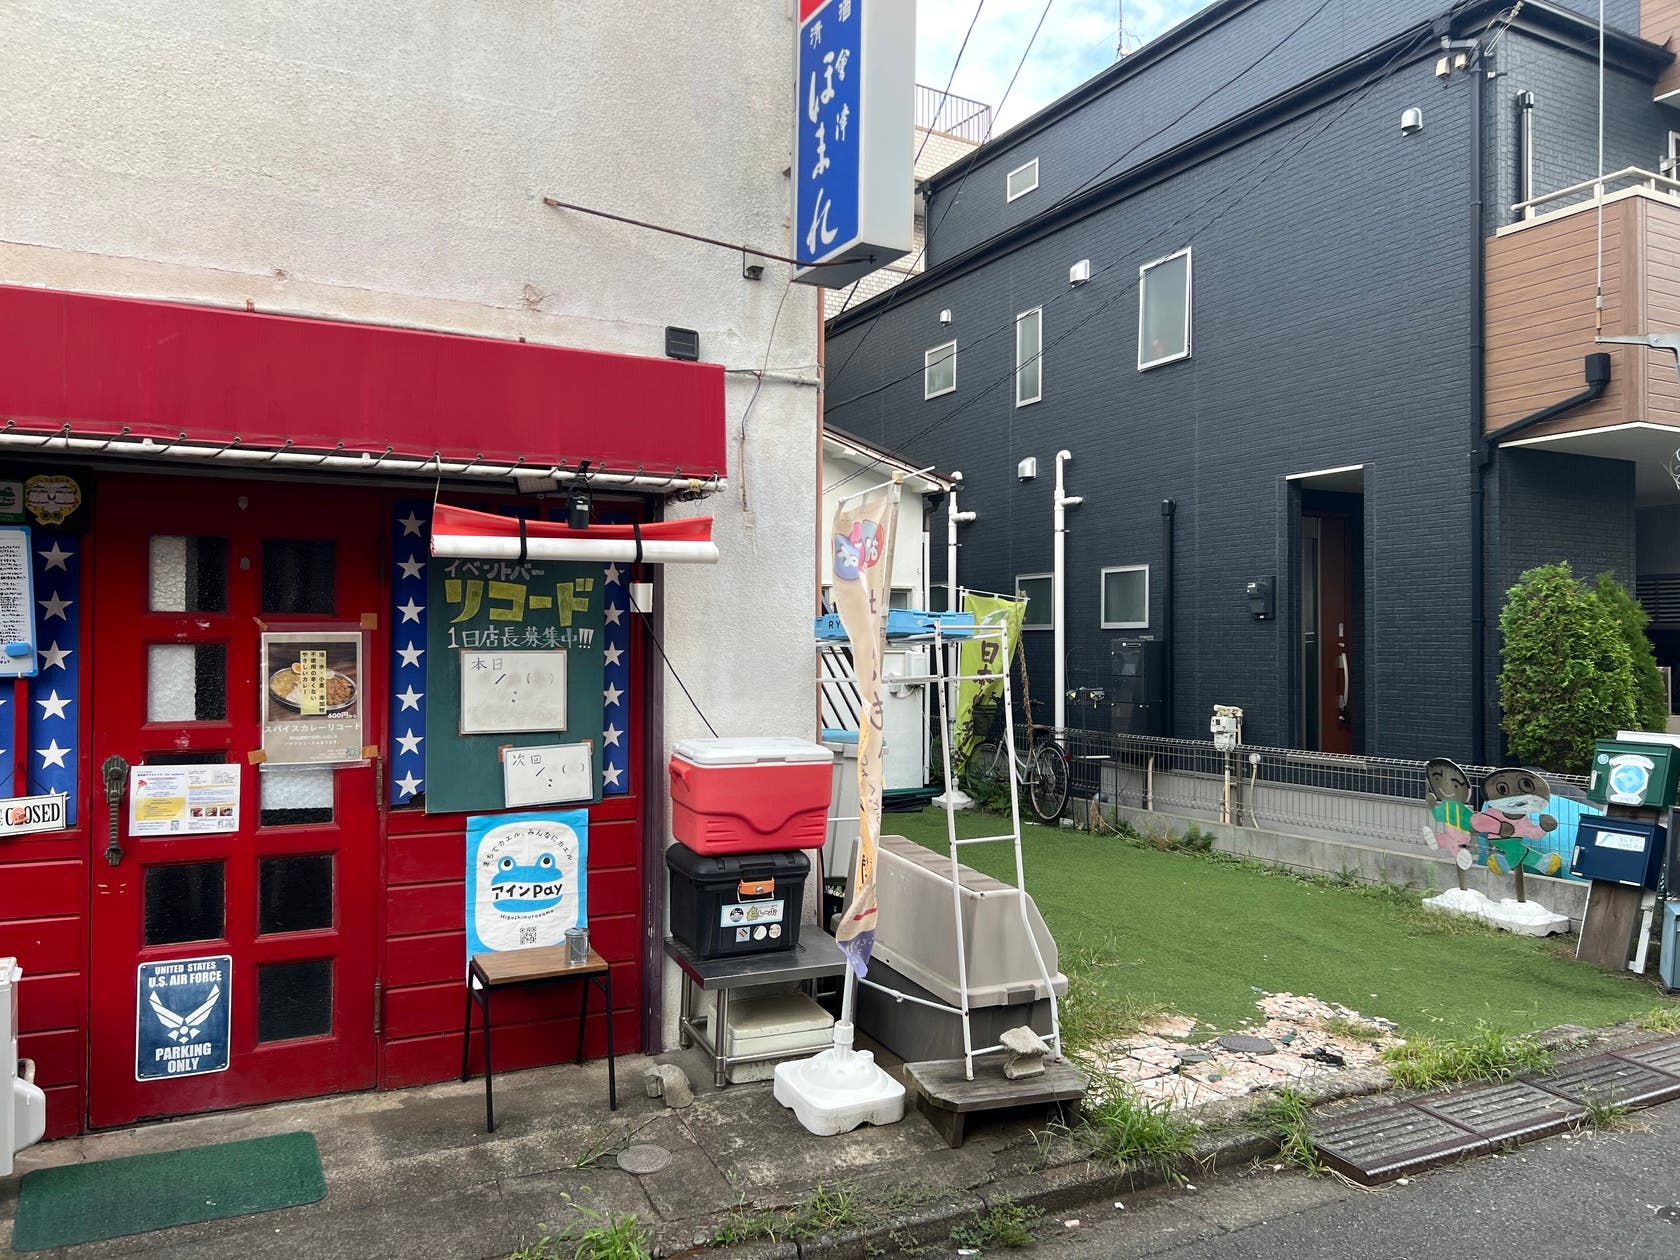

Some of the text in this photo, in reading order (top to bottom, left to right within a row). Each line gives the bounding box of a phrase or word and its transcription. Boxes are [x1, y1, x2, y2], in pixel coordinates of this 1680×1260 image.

[806, 50, 838, 254] ほまれ
[444, 559, 545, 581] イベントバー
[444, 577, 595, 627] リコード
[471, 657, 504, 671] 本日
[264, 722, 361, 734] スパイスカレーリコード
[512, 753, 542, 767] 次回
[5, 803, 61, 826] COSED
[154, 961, 217, 975] UNITED STATES
[148, 970, 222, 988] U.S. AIR FORCE
[155, 1042, 212, 1061] PARKING
[167, 1058, 200, 1074] ONLY
